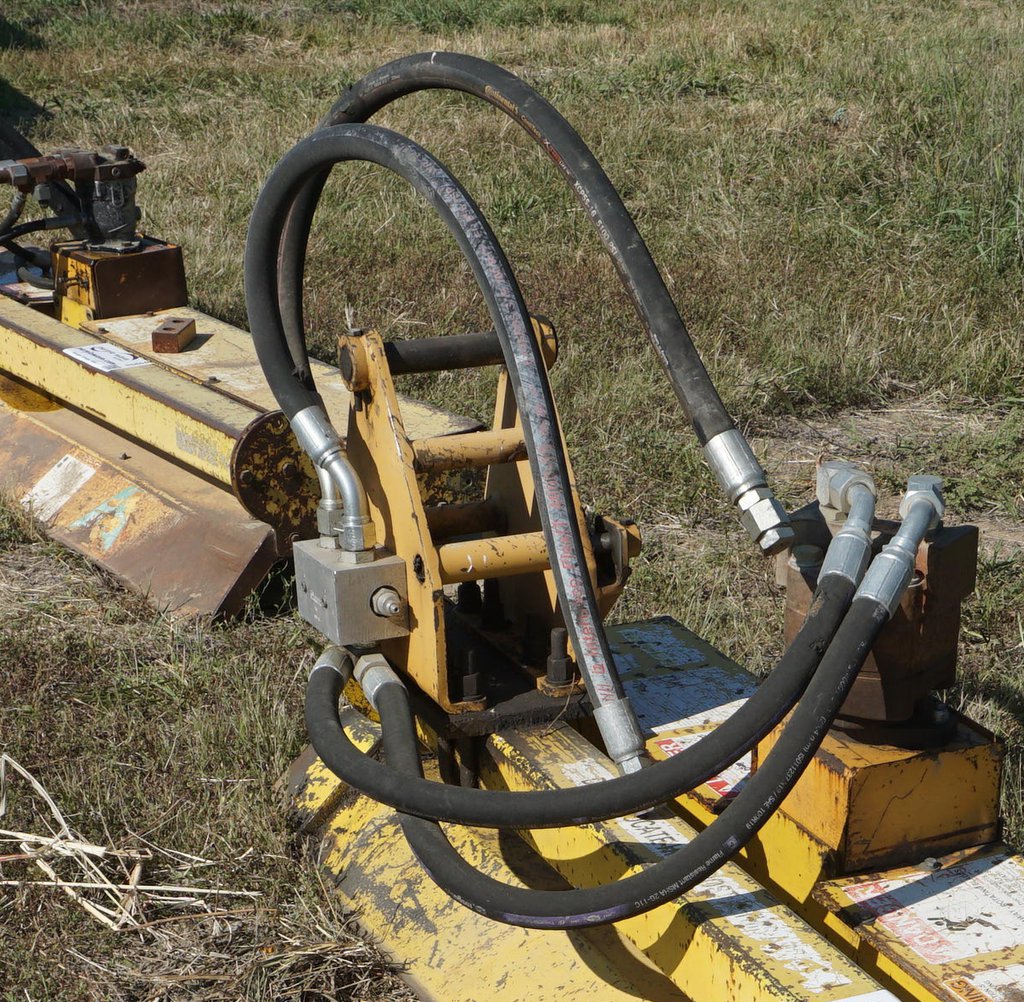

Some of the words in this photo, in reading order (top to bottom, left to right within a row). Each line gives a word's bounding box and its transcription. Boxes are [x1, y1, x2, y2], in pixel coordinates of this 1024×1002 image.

[704, 849, 725, 868] Flame
[678, 863, 707, 887] Resistant
[658, 881, 680, 898] MSHA
